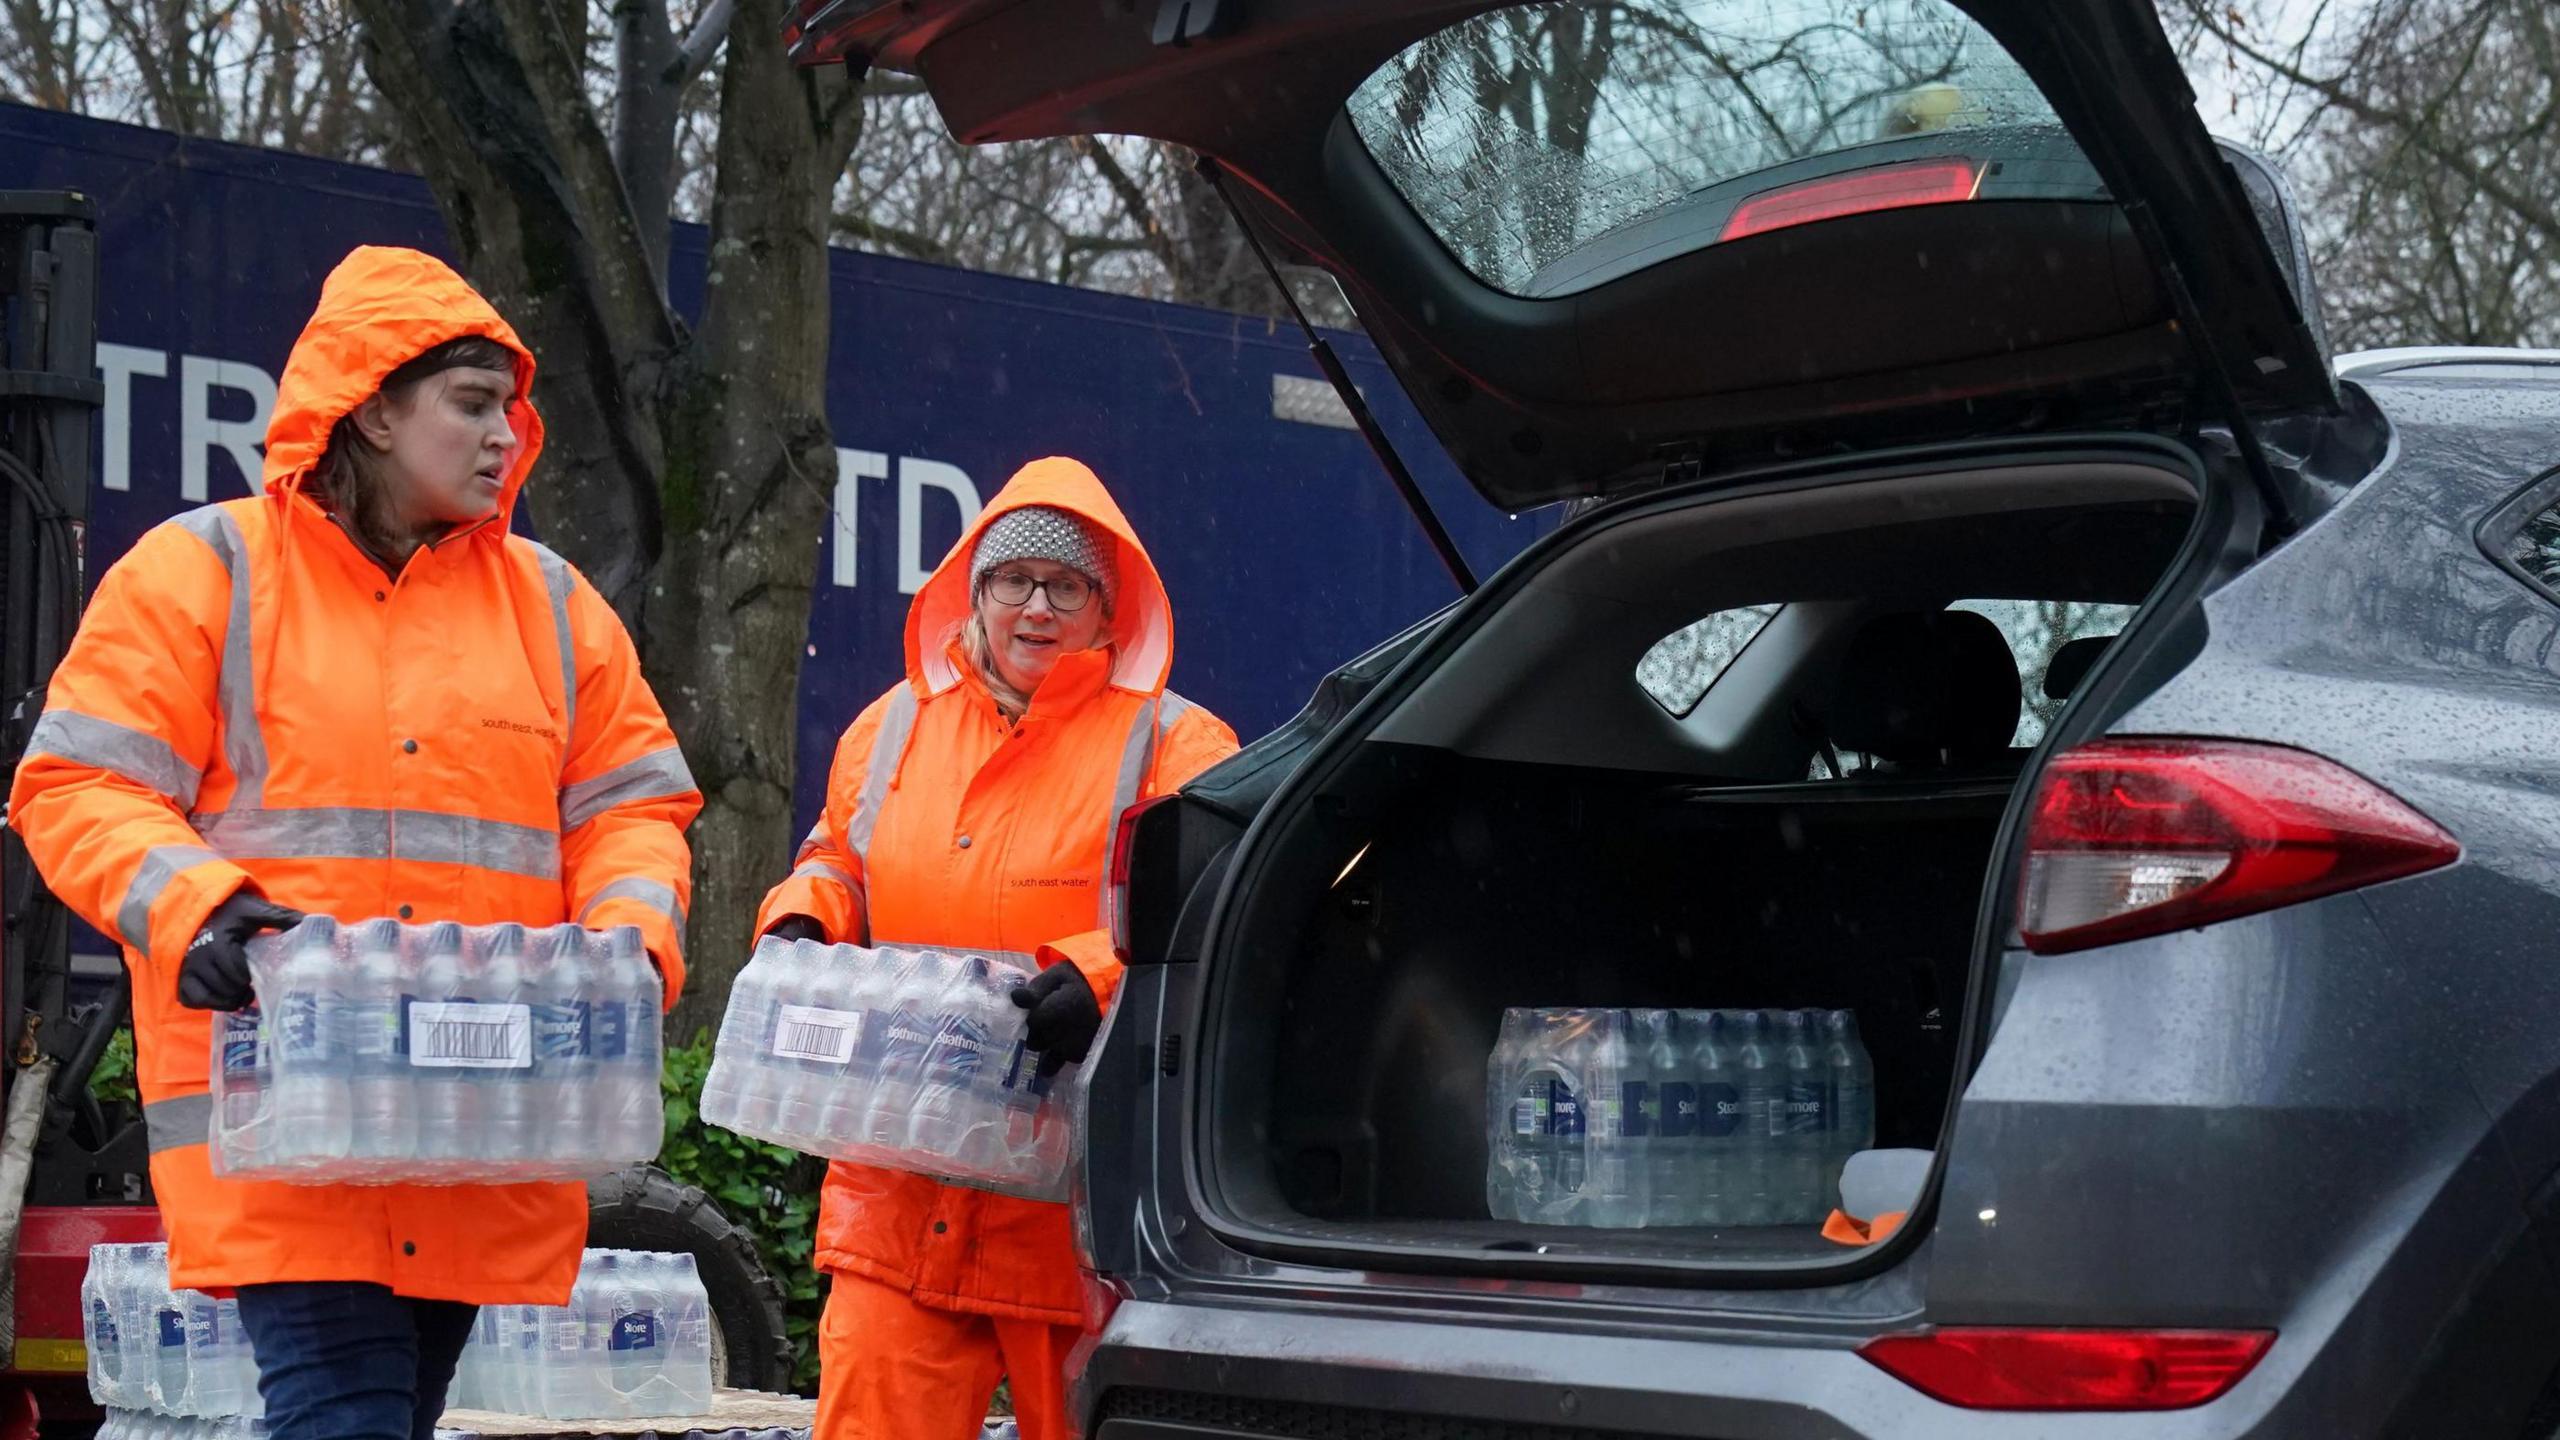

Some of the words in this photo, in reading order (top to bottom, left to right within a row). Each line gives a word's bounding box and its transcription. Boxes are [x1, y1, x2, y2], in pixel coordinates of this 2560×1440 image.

[481, 718, 511, 730] south
[511, 723, 533, 735] east
[1010, 878, 1037, 888] south
[1038, 878, 1059, 887] east
[1060, 878, 1090, 888] water
